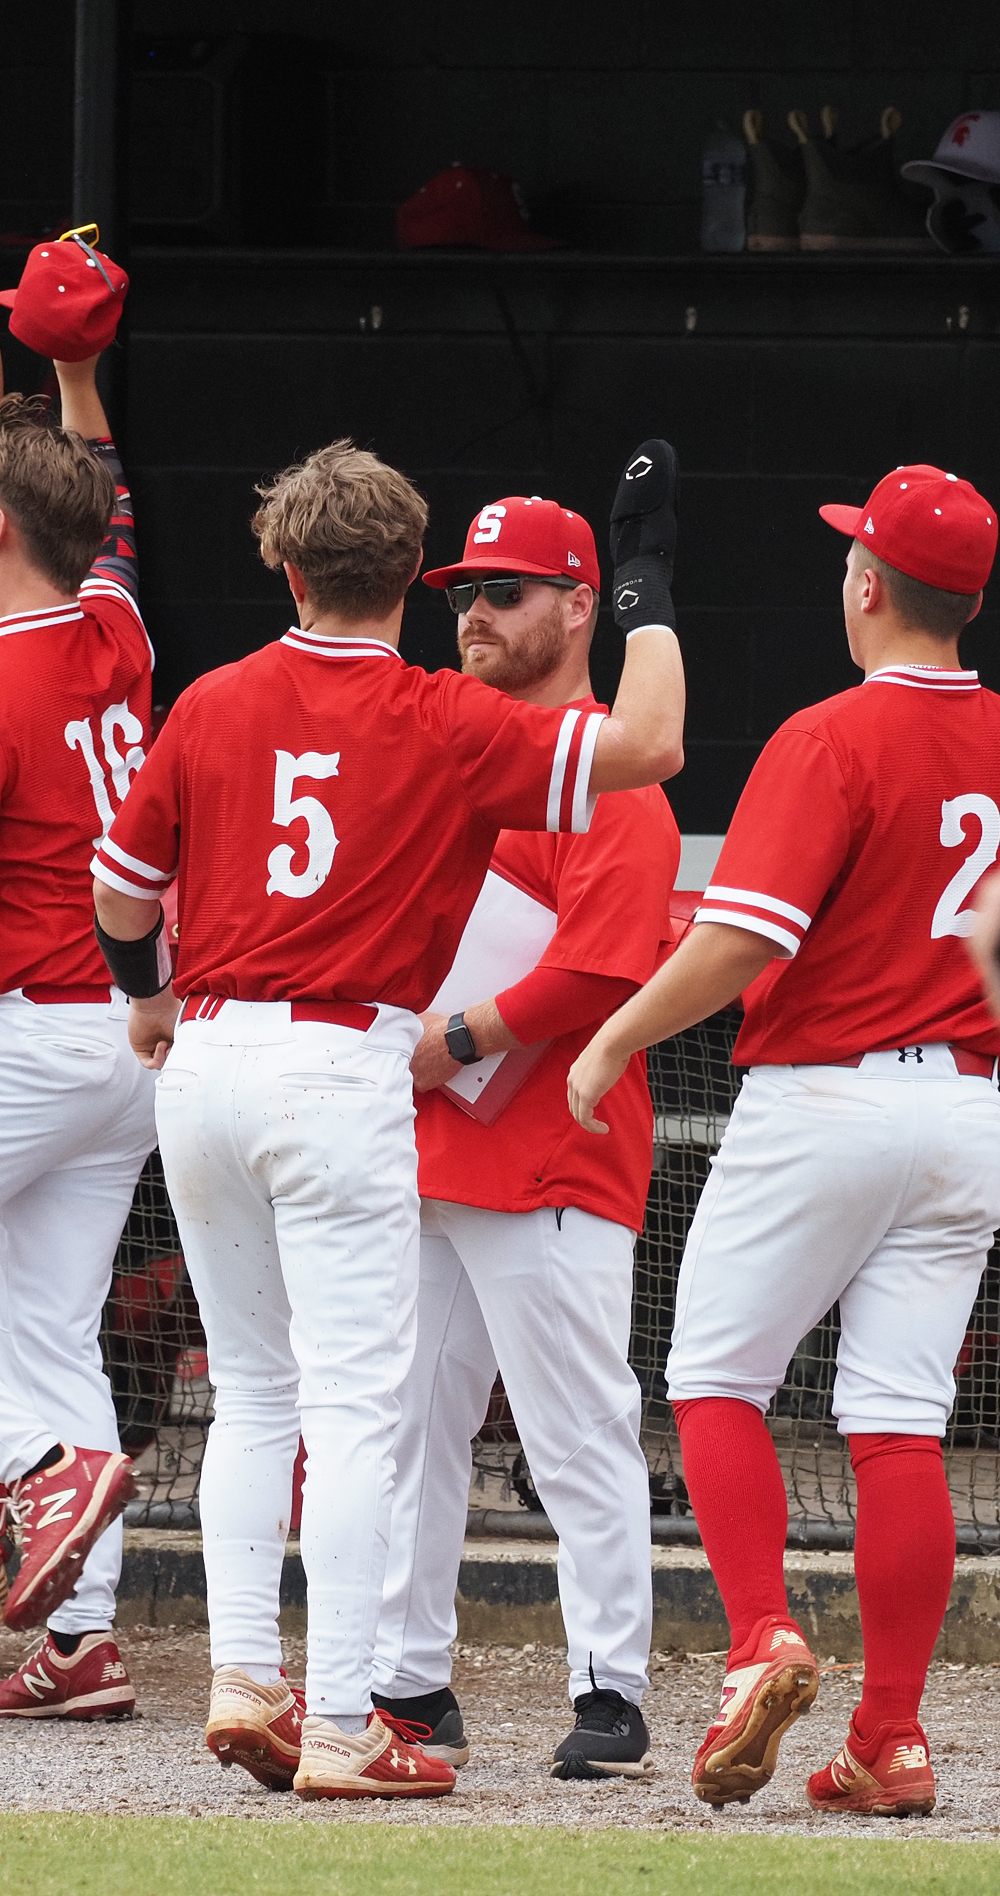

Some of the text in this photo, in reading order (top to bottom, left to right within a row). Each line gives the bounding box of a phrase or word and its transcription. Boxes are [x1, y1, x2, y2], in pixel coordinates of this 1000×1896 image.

[473, 505, 507, 544] S
[64, 695, 146, 851] 16
[266, 750, 340, 898] 5
[217, 1688, 262, 1707] ARMOUR
[307, 1740, 351, 1759] ARMOUR
